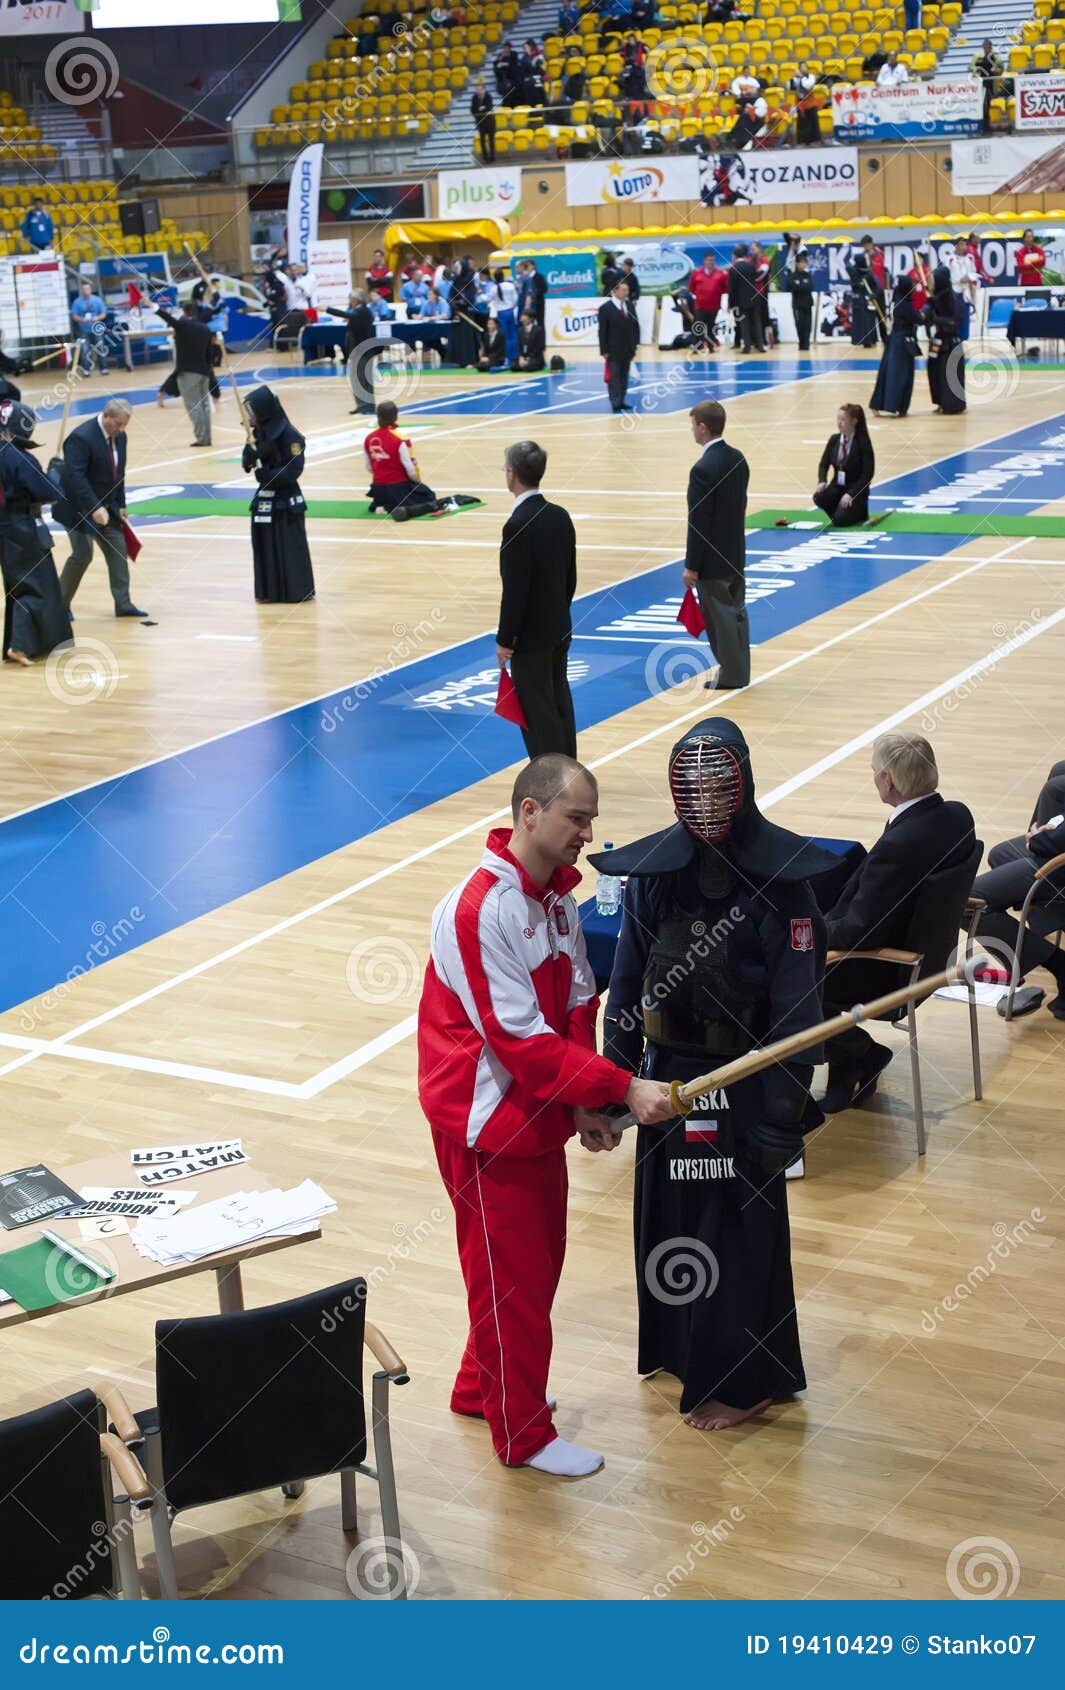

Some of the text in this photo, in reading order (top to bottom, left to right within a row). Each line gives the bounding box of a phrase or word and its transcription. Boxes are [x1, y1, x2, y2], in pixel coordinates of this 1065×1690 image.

[614, 172, 652, 197] LOTTO
[750, 163, 855, 184] TOZANDO
[446, 180, 495, 208] plus
[300, 160, 312, 264] RADMOR
[692, 1088, 730, 1111] LSKA
[133, 1143, 239, 1162] ATCH
[140, 1150, 247, 1183] MATCH
[670, 1157, 737, 1180] KRYSZTOFIK
[96, 1219, 116, 1233] 2
